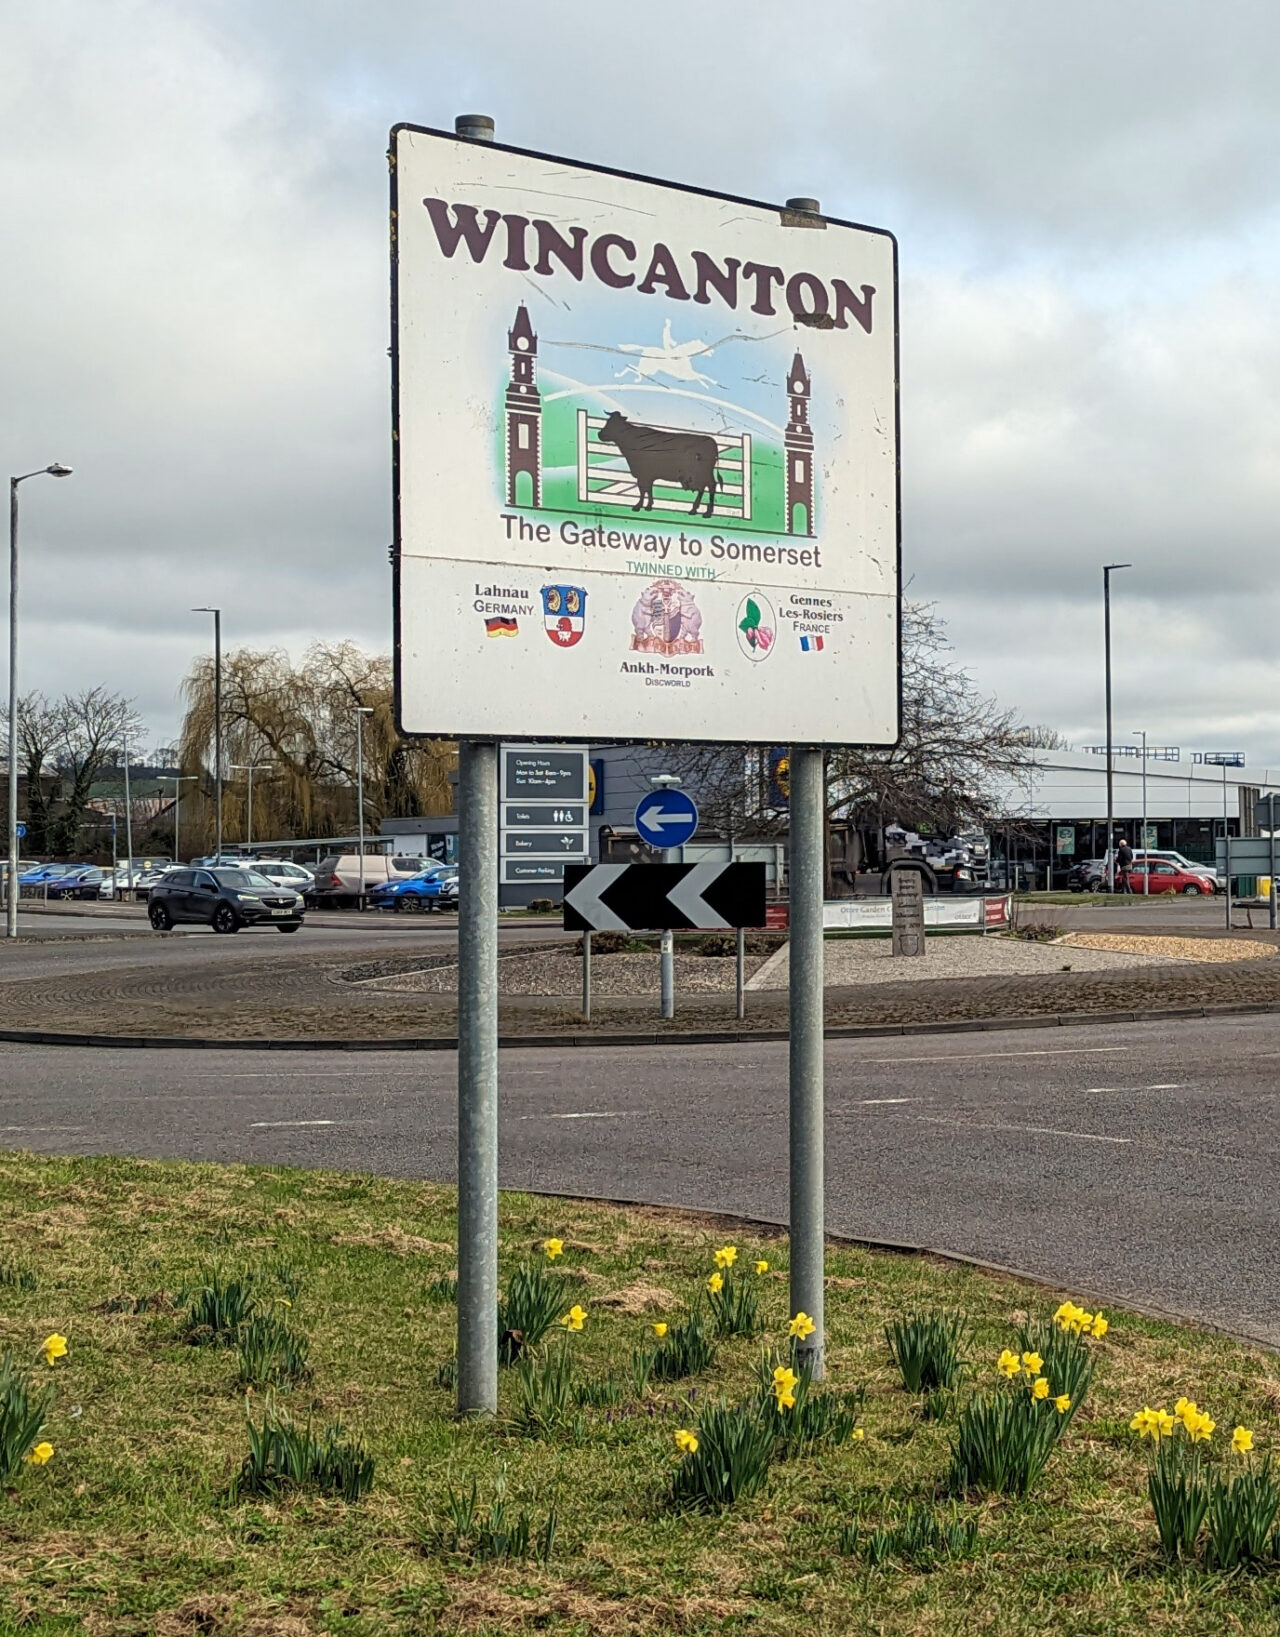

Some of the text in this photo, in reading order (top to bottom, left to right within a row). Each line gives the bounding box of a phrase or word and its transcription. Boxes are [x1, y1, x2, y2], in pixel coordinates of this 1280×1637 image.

[423, 198, 876, 333] WINCANTON
[500, 513, 822, 568] The Gateway to Somerset
[626, 560, 716, 579] TWINNED WITH
[475, 583, 529, 599] Lahnau
[473, 599, 534, 615] GERMANY
[789, 594, 833, 608] Gennes
[779, 607, 844, 622] Les-Rosiers
[793, 621, 831, 634] FRANCE
[619, 661, 715, 678] Ankh-Morpork
